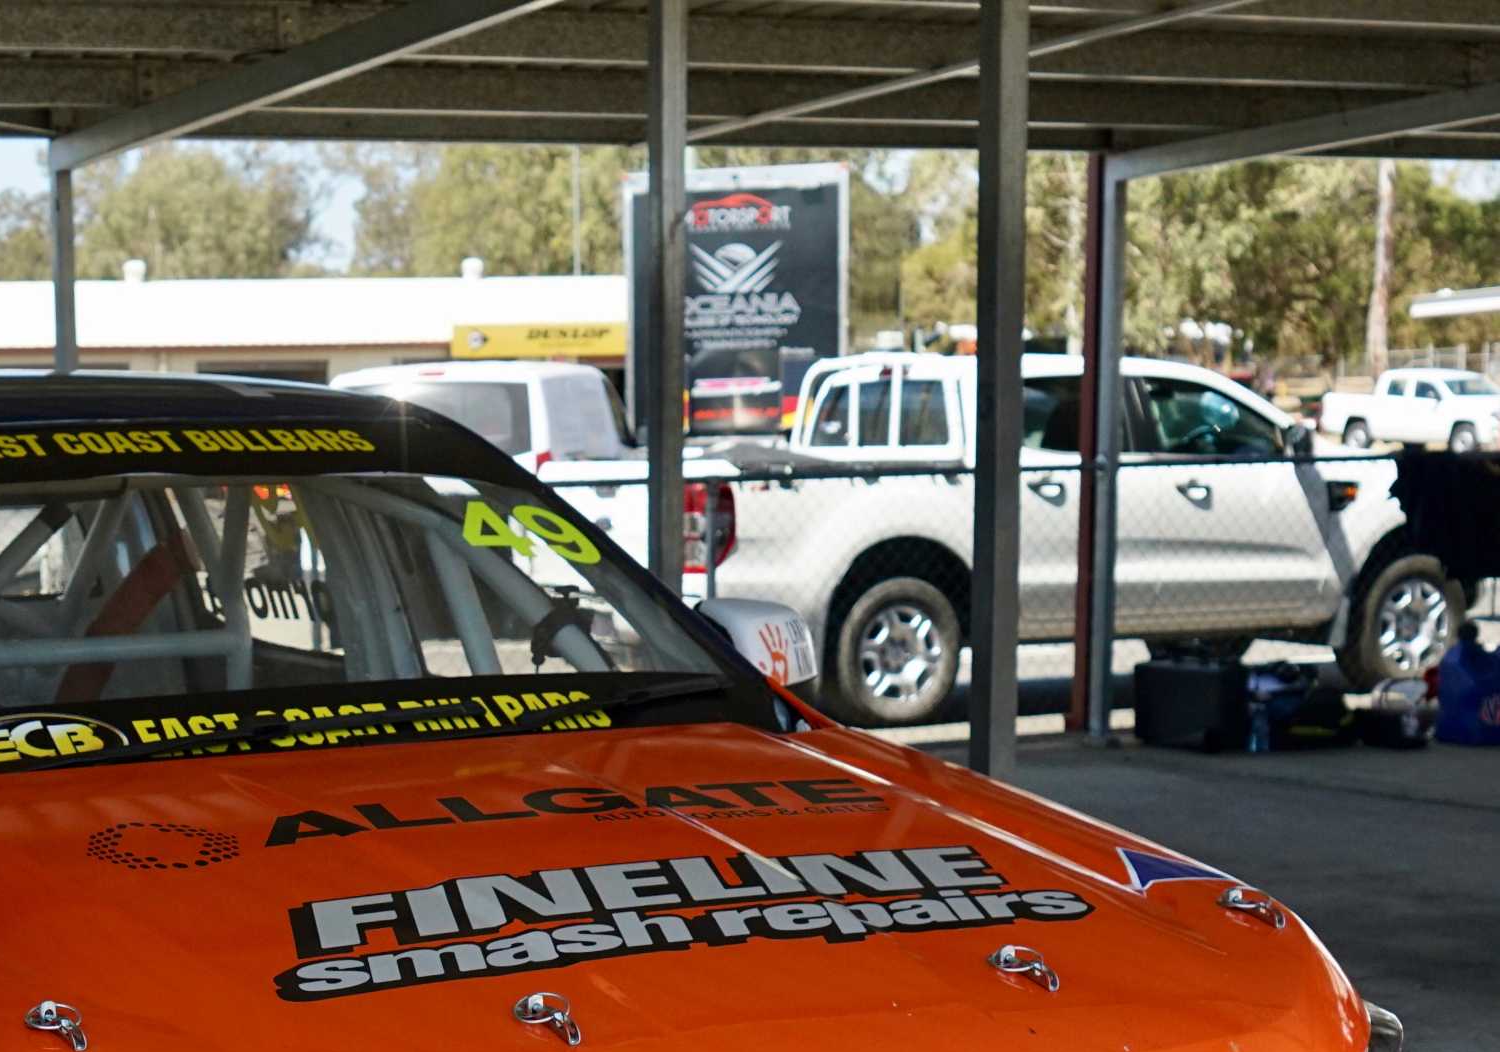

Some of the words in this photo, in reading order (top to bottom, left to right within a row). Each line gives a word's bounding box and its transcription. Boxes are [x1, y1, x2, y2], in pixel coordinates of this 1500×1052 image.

[526, 328, 610, 340] DUNLOP
[52, 431, 182, 455] COAST
[182, 429, 376, 452] BULLBARS
[462, 500, 602, 566] 49
[265, 777, 886, 849] ALLGATE
[311, 846, 1004, 949] FINELINE
[296, 911, 696, 994] smash
[711, 888, 1091, 937] repairs
